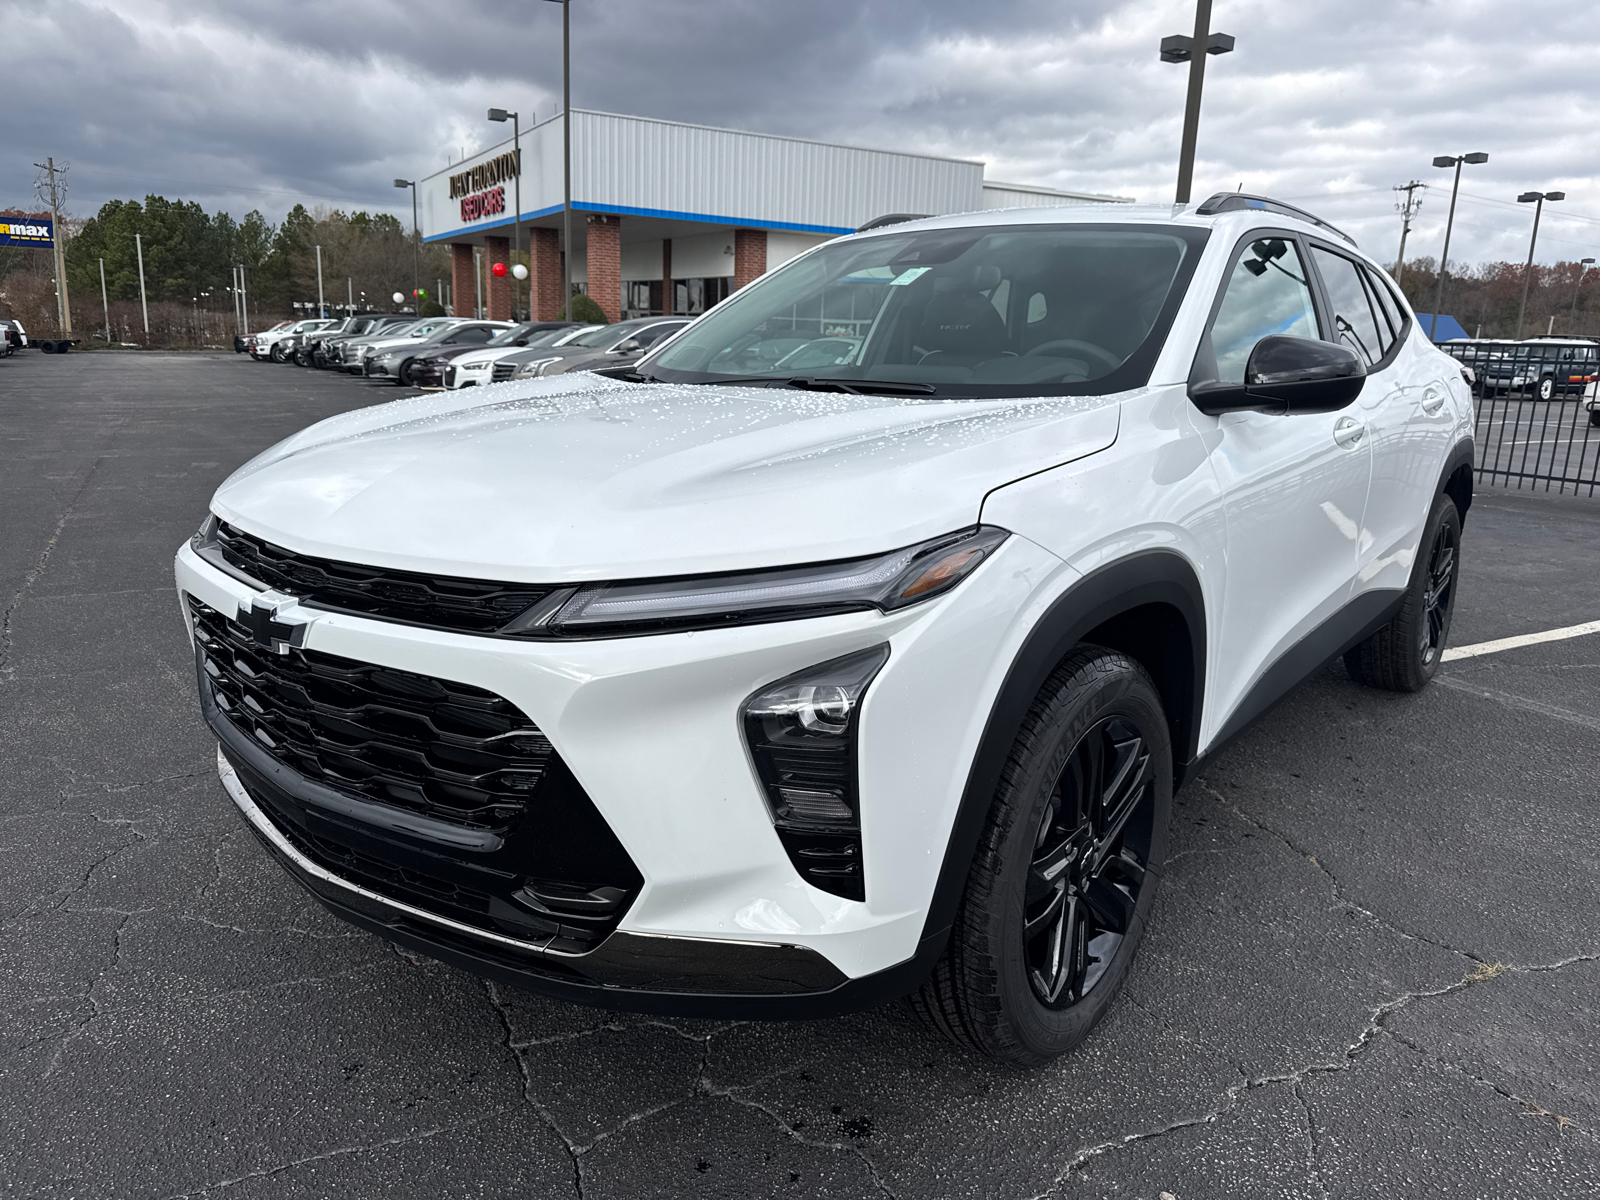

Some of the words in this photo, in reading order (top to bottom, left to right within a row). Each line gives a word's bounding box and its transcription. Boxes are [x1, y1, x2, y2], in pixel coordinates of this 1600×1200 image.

[449, 171, 470, 199] JOHN
[460, 194, 481, 221] USED
[480, 186, 505, 217] CARS
[1029, 695, 1099, 831] ASSURANCE
